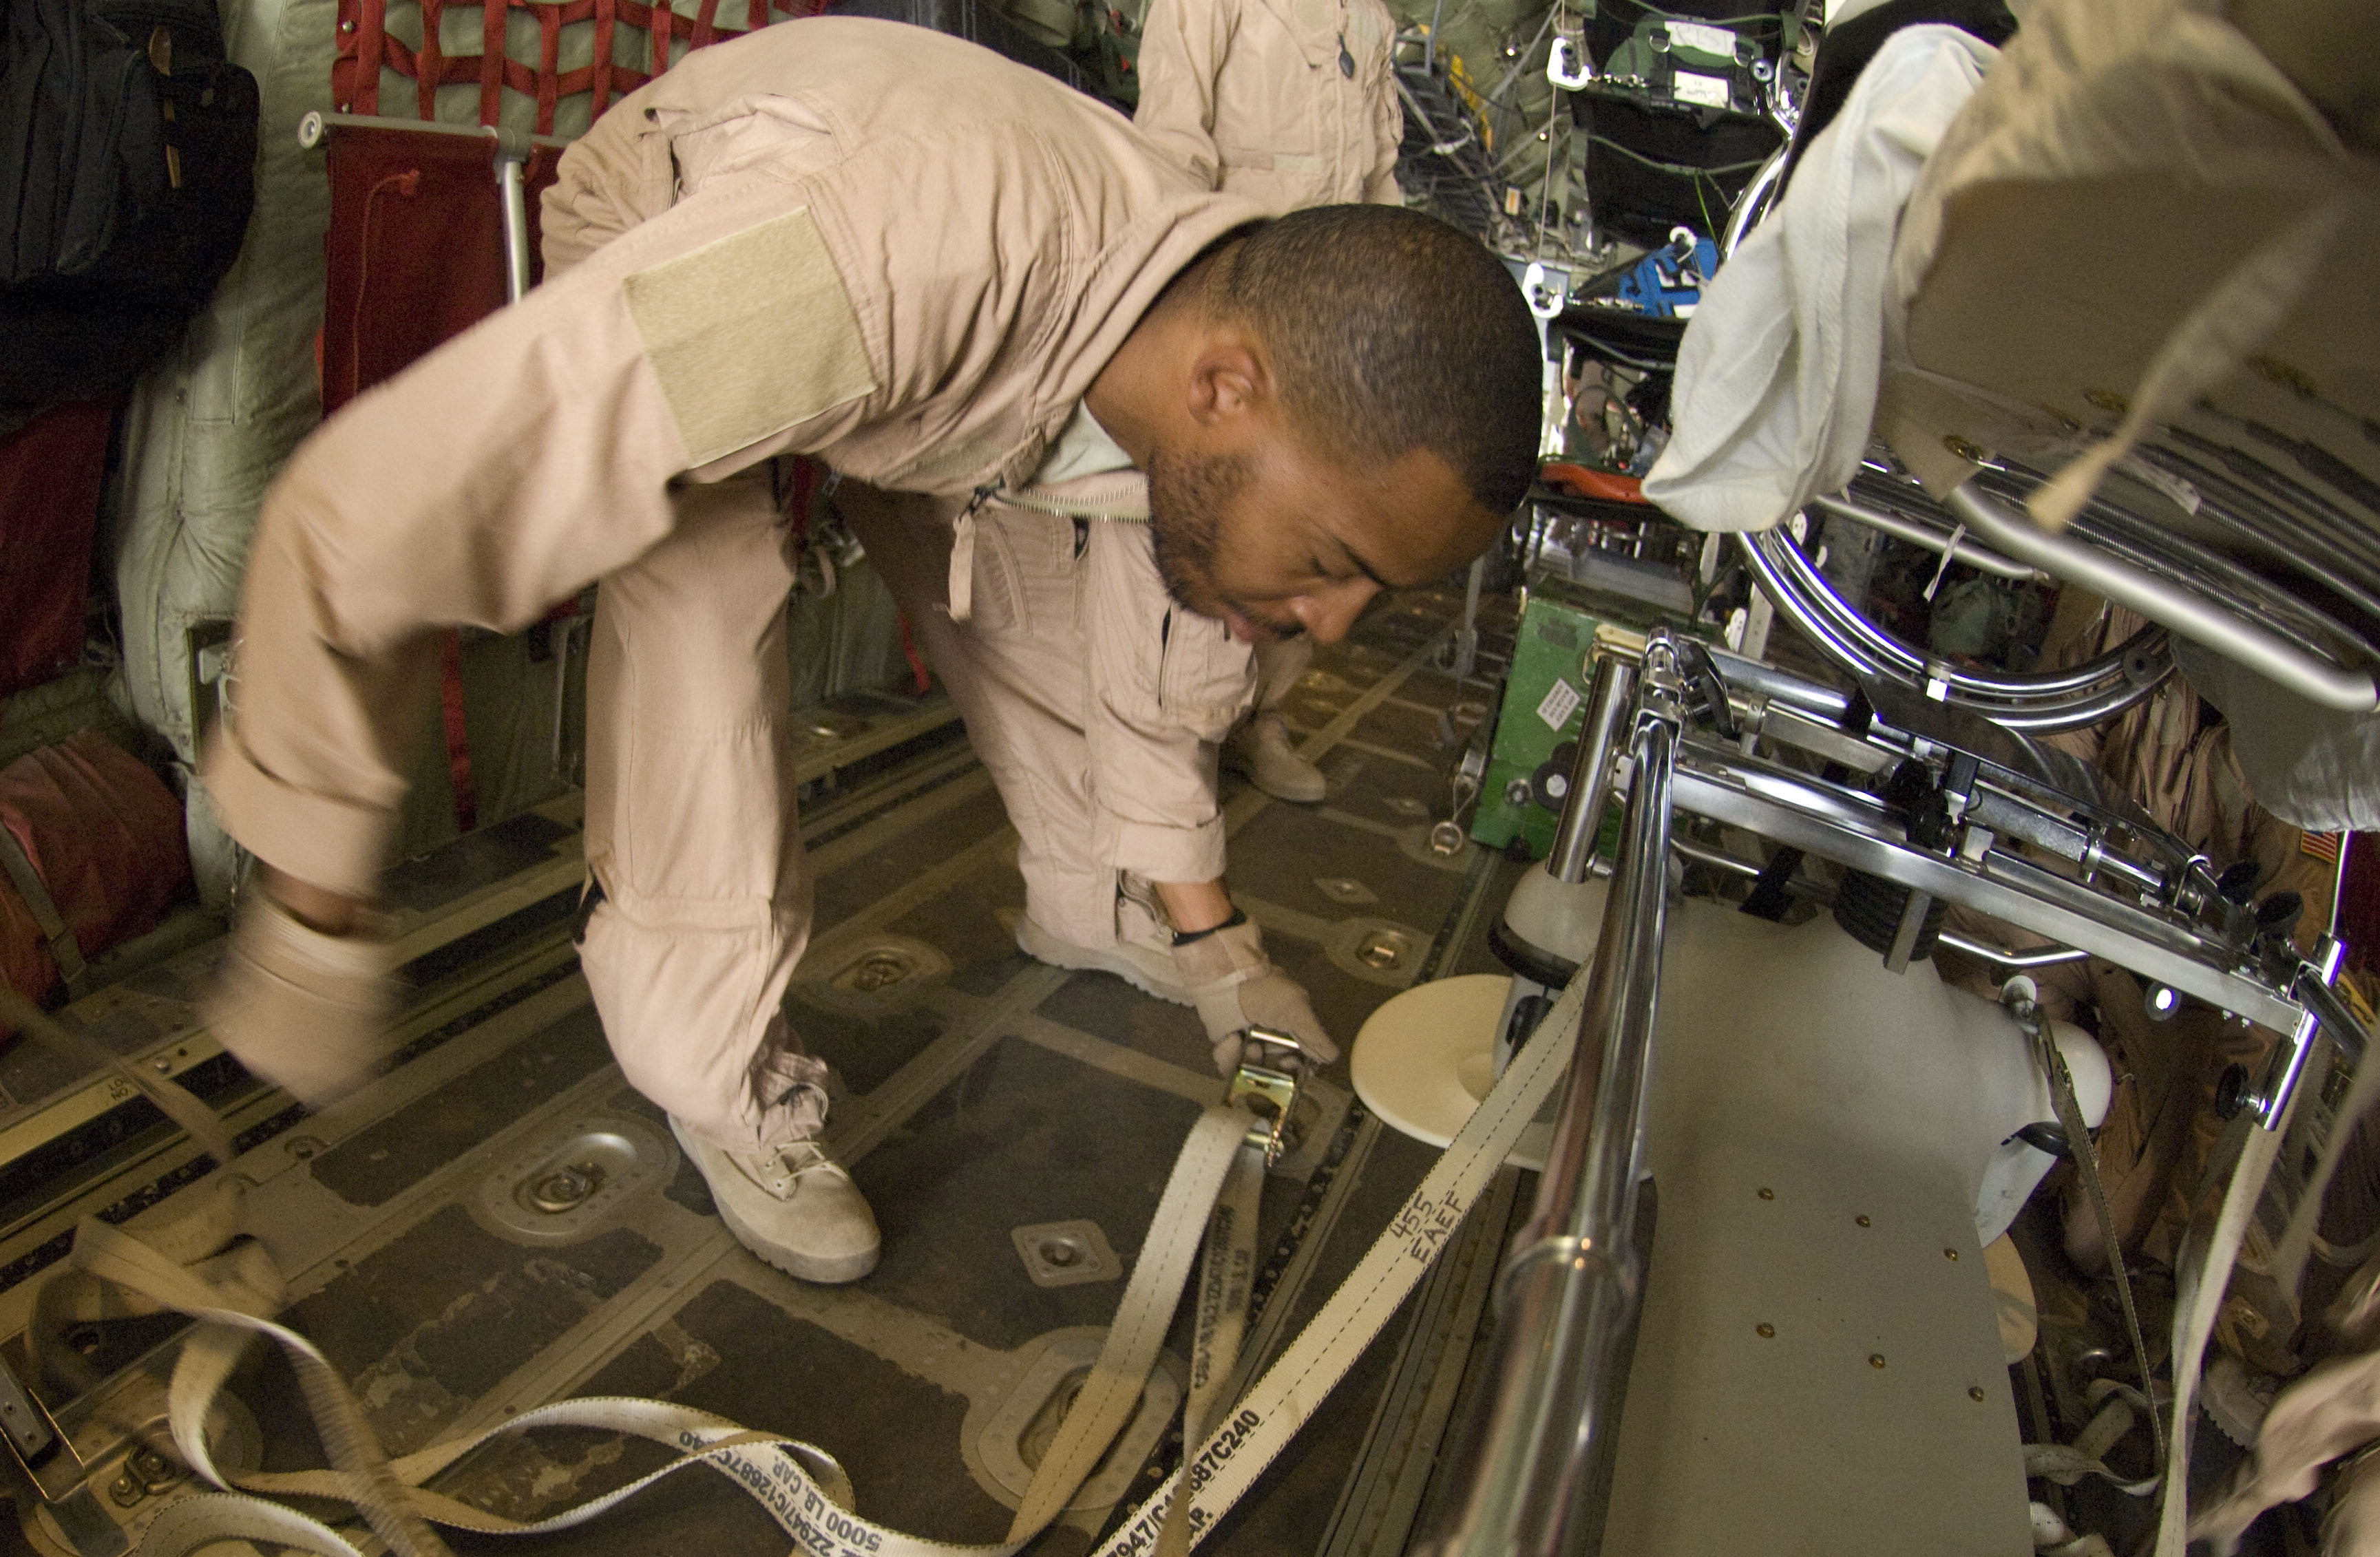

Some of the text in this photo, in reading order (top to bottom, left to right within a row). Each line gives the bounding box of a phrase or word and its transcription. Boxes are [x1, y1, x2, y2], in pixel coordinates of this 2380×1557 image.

[1389, 1191, 1433, 1238] 455
[1410, 1190, 1463, 1263] EAEF
[772, 1455, 883, 1552] 5000 LB. CAP.
